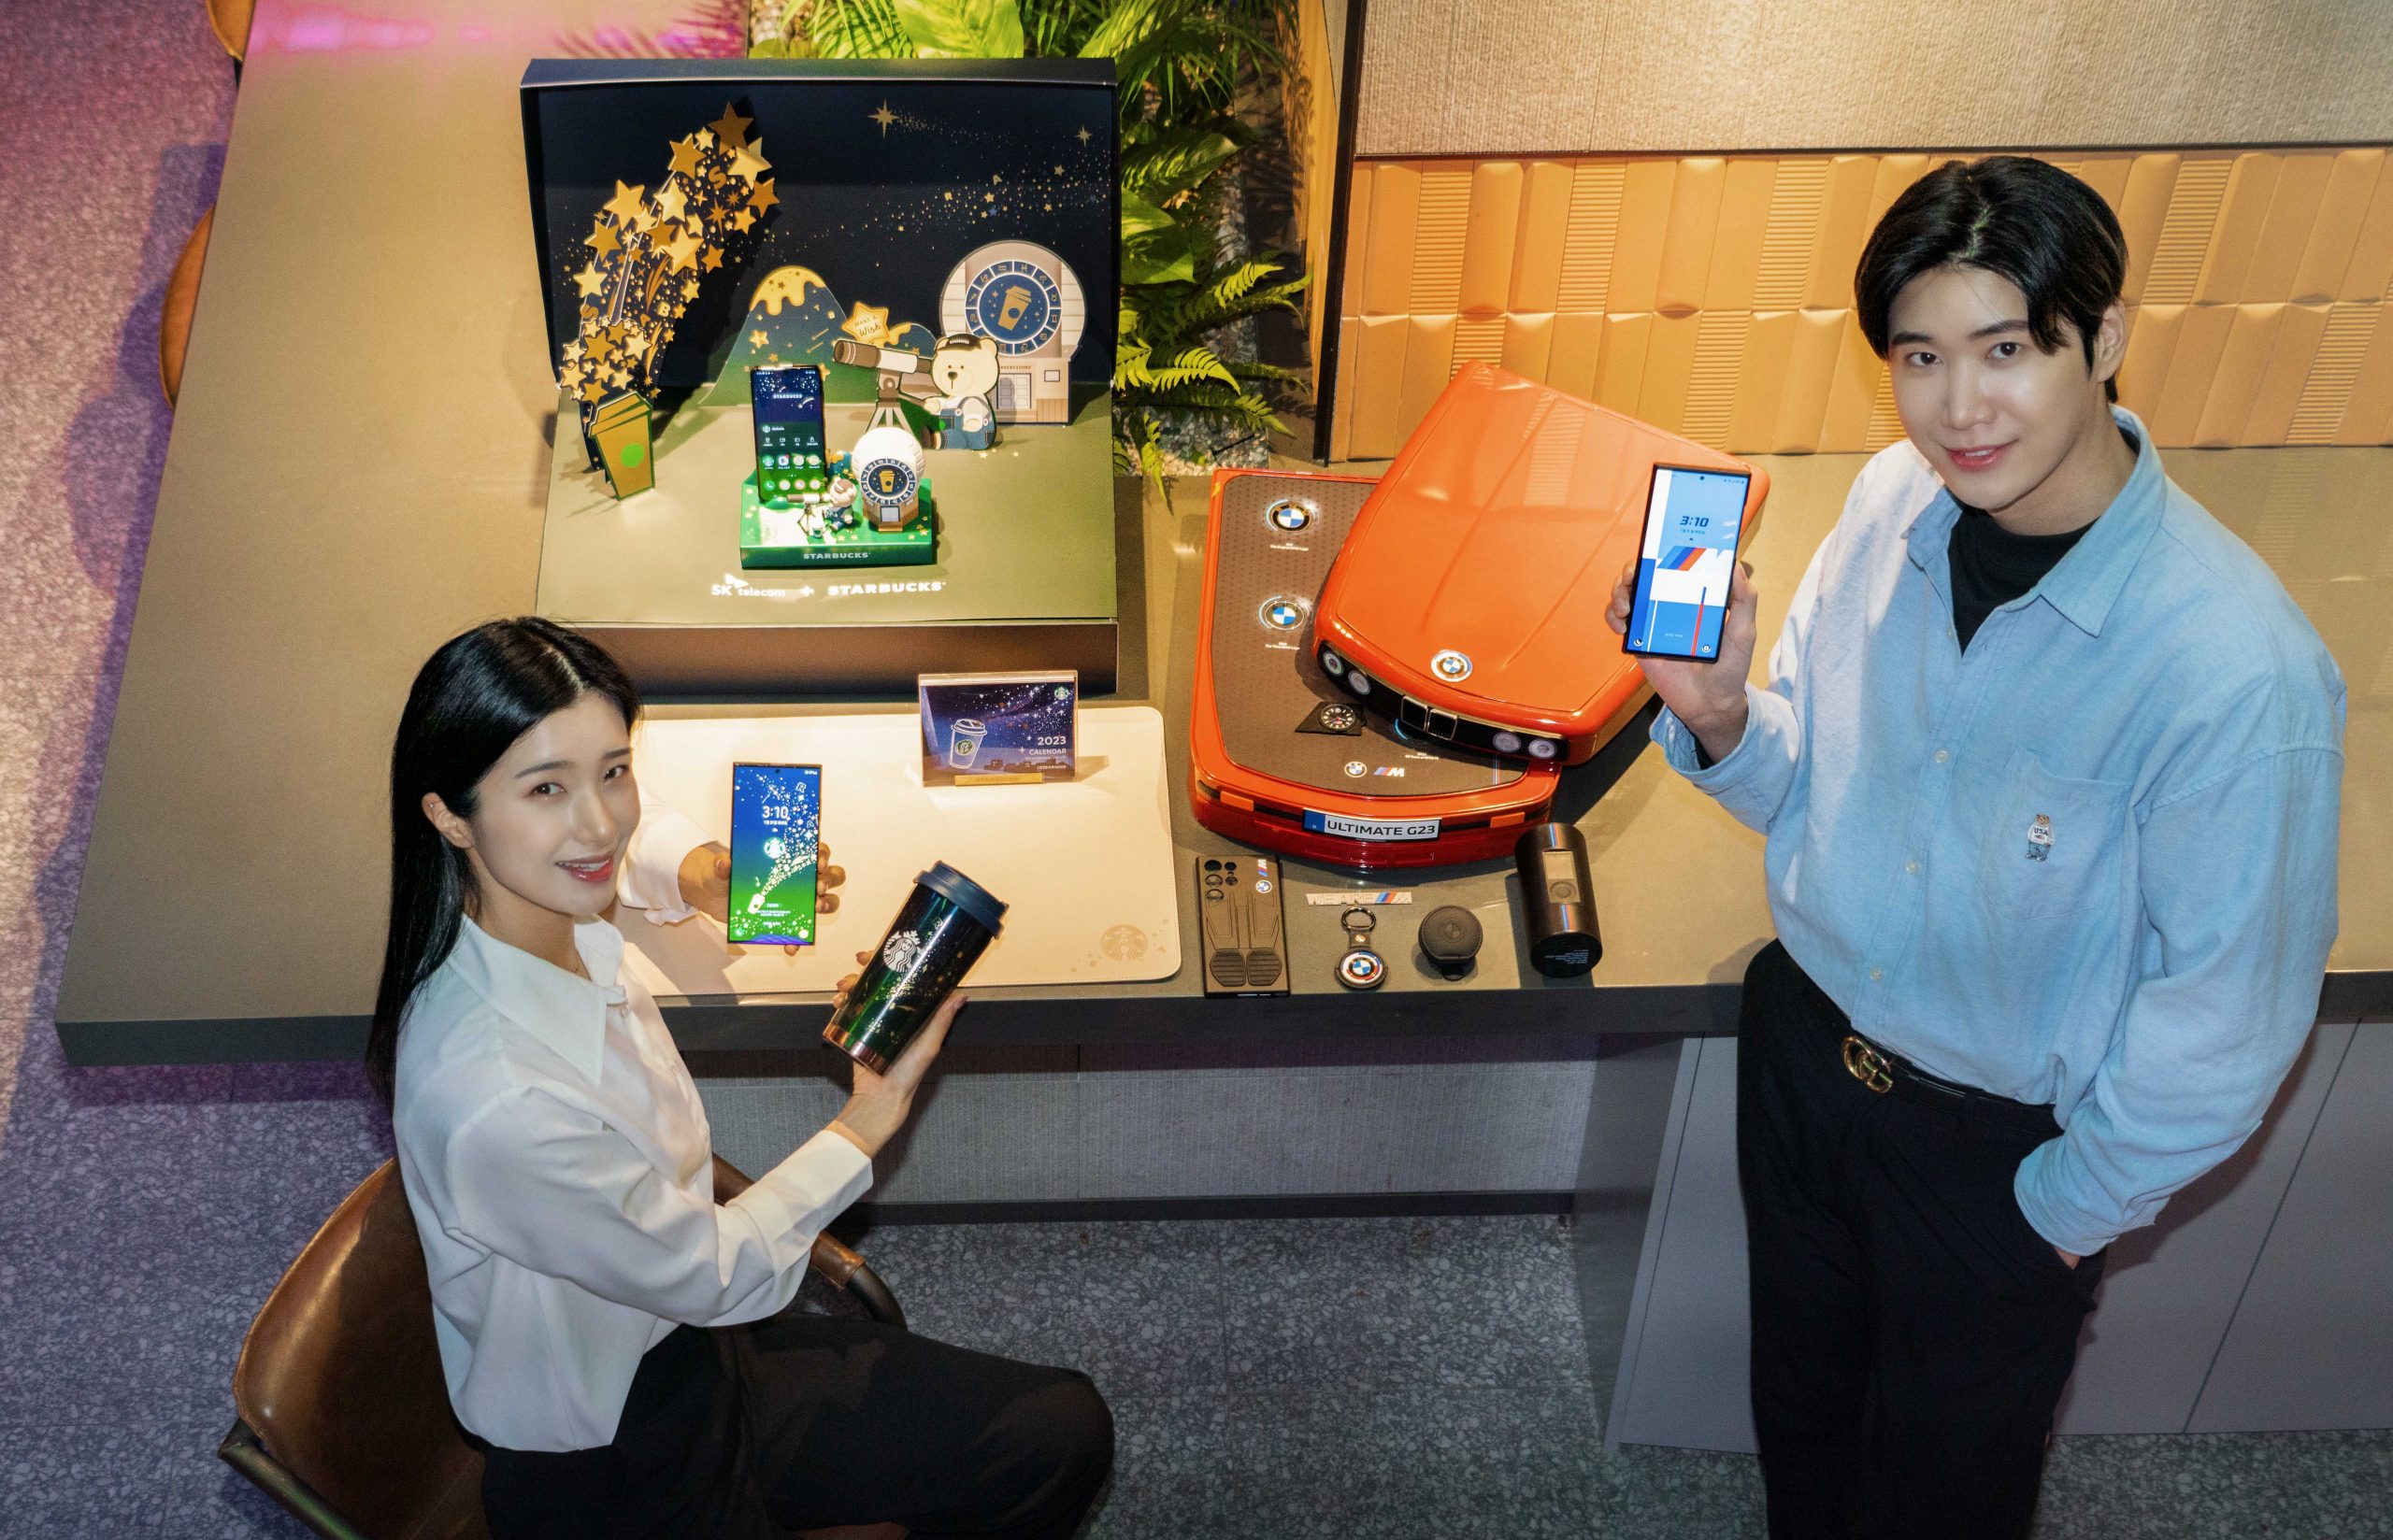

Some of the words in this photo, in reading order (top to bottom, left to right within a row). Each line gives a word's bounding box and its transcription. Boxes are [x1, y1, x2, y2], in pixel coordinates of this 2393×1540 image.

[708, 165, 727, 190] S
[859, 323, 881, 337] Wish
[1680, 515, 1710, 527] 3:10
[711, 584, 734, 597] SK
[737, 587, 786, 597] telecom
[827, 581, 943, 596] STARBUCKS
[1038, 735, 1067, 746] 2023
[762, 806, 789, 819] 3:10
[1326, 820, 1403, 836] ULTIMATE
[1407, 825, 1436, 835] G23
[1306, 893, 1334, 906] WE
[1338, 892, 1375, 905] ARE
